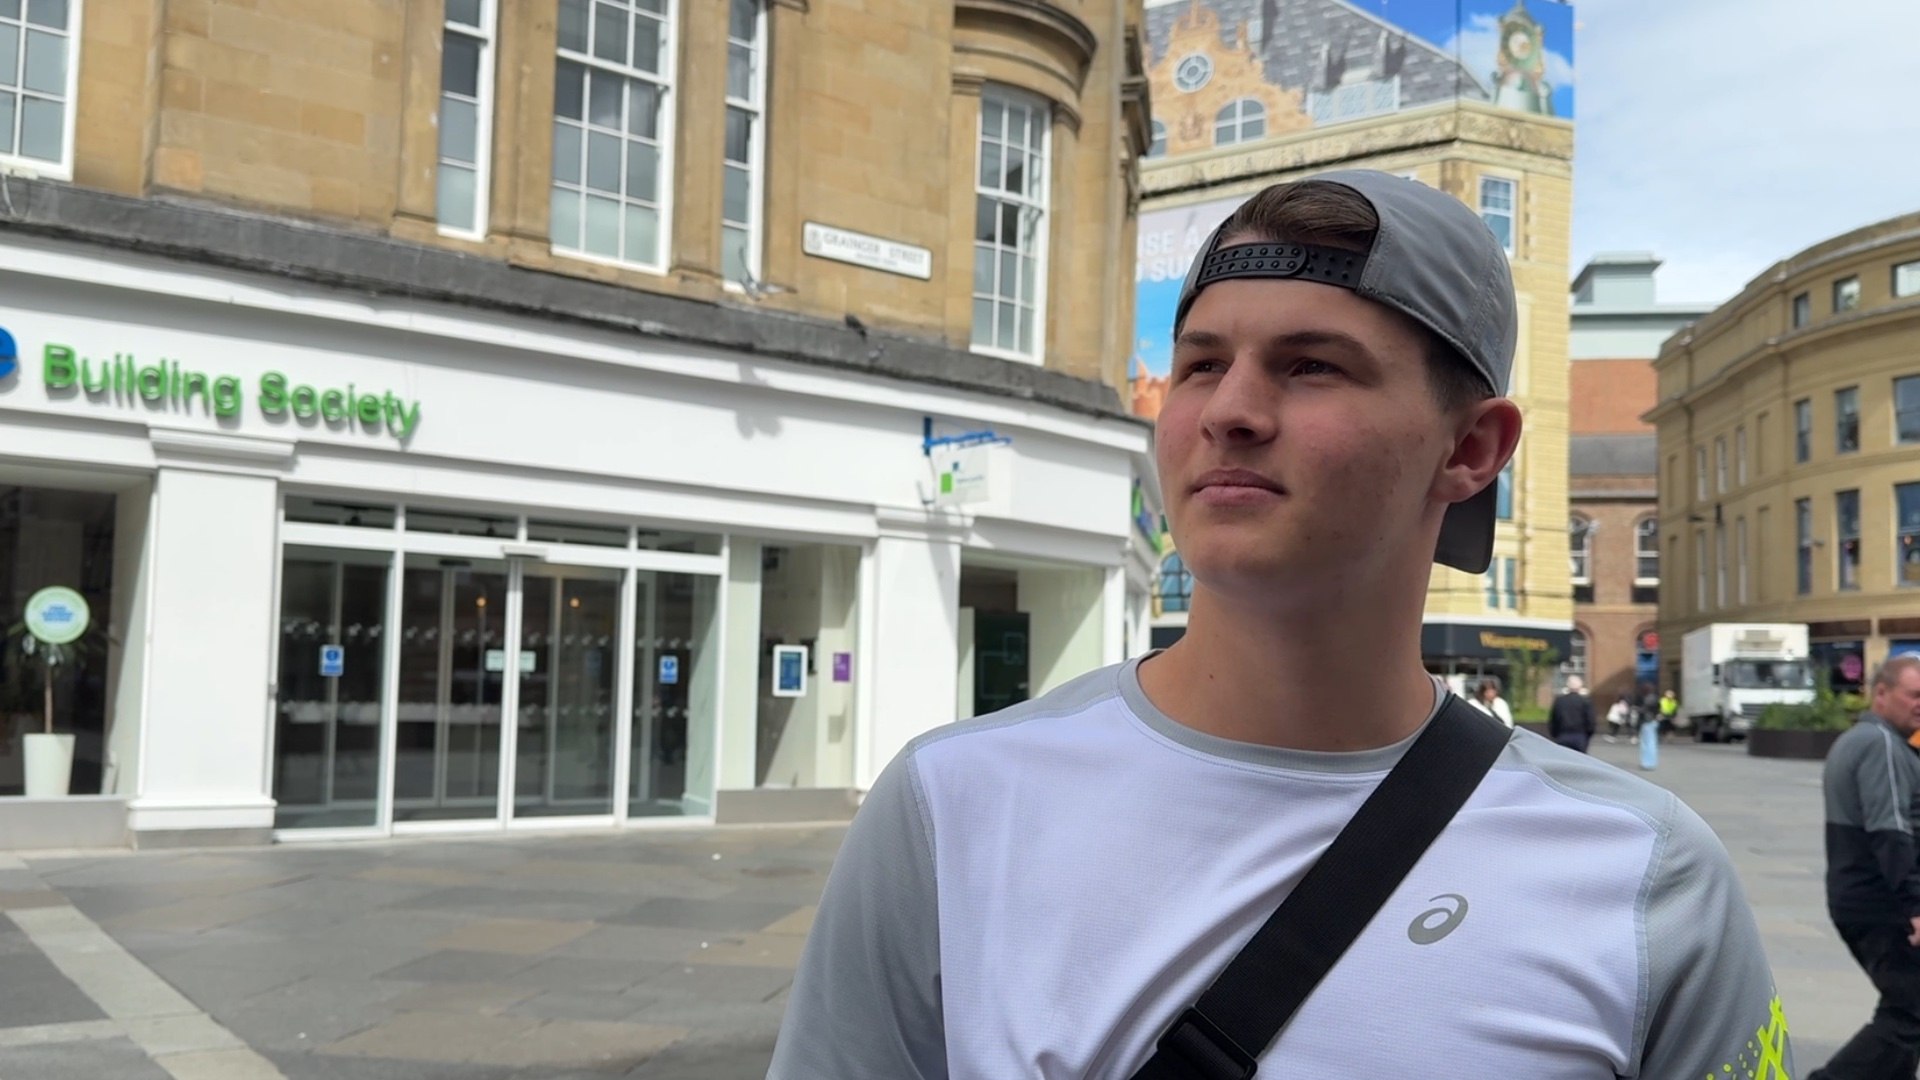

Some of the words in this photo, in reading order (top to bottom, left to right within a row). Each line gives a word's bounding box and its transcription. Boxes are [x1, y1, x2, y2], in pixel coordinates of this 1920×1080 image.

[1150, 254, 1189, 281] SU
[44, 344, 242, 418] Building
[258, 370, 419, 439] Society
